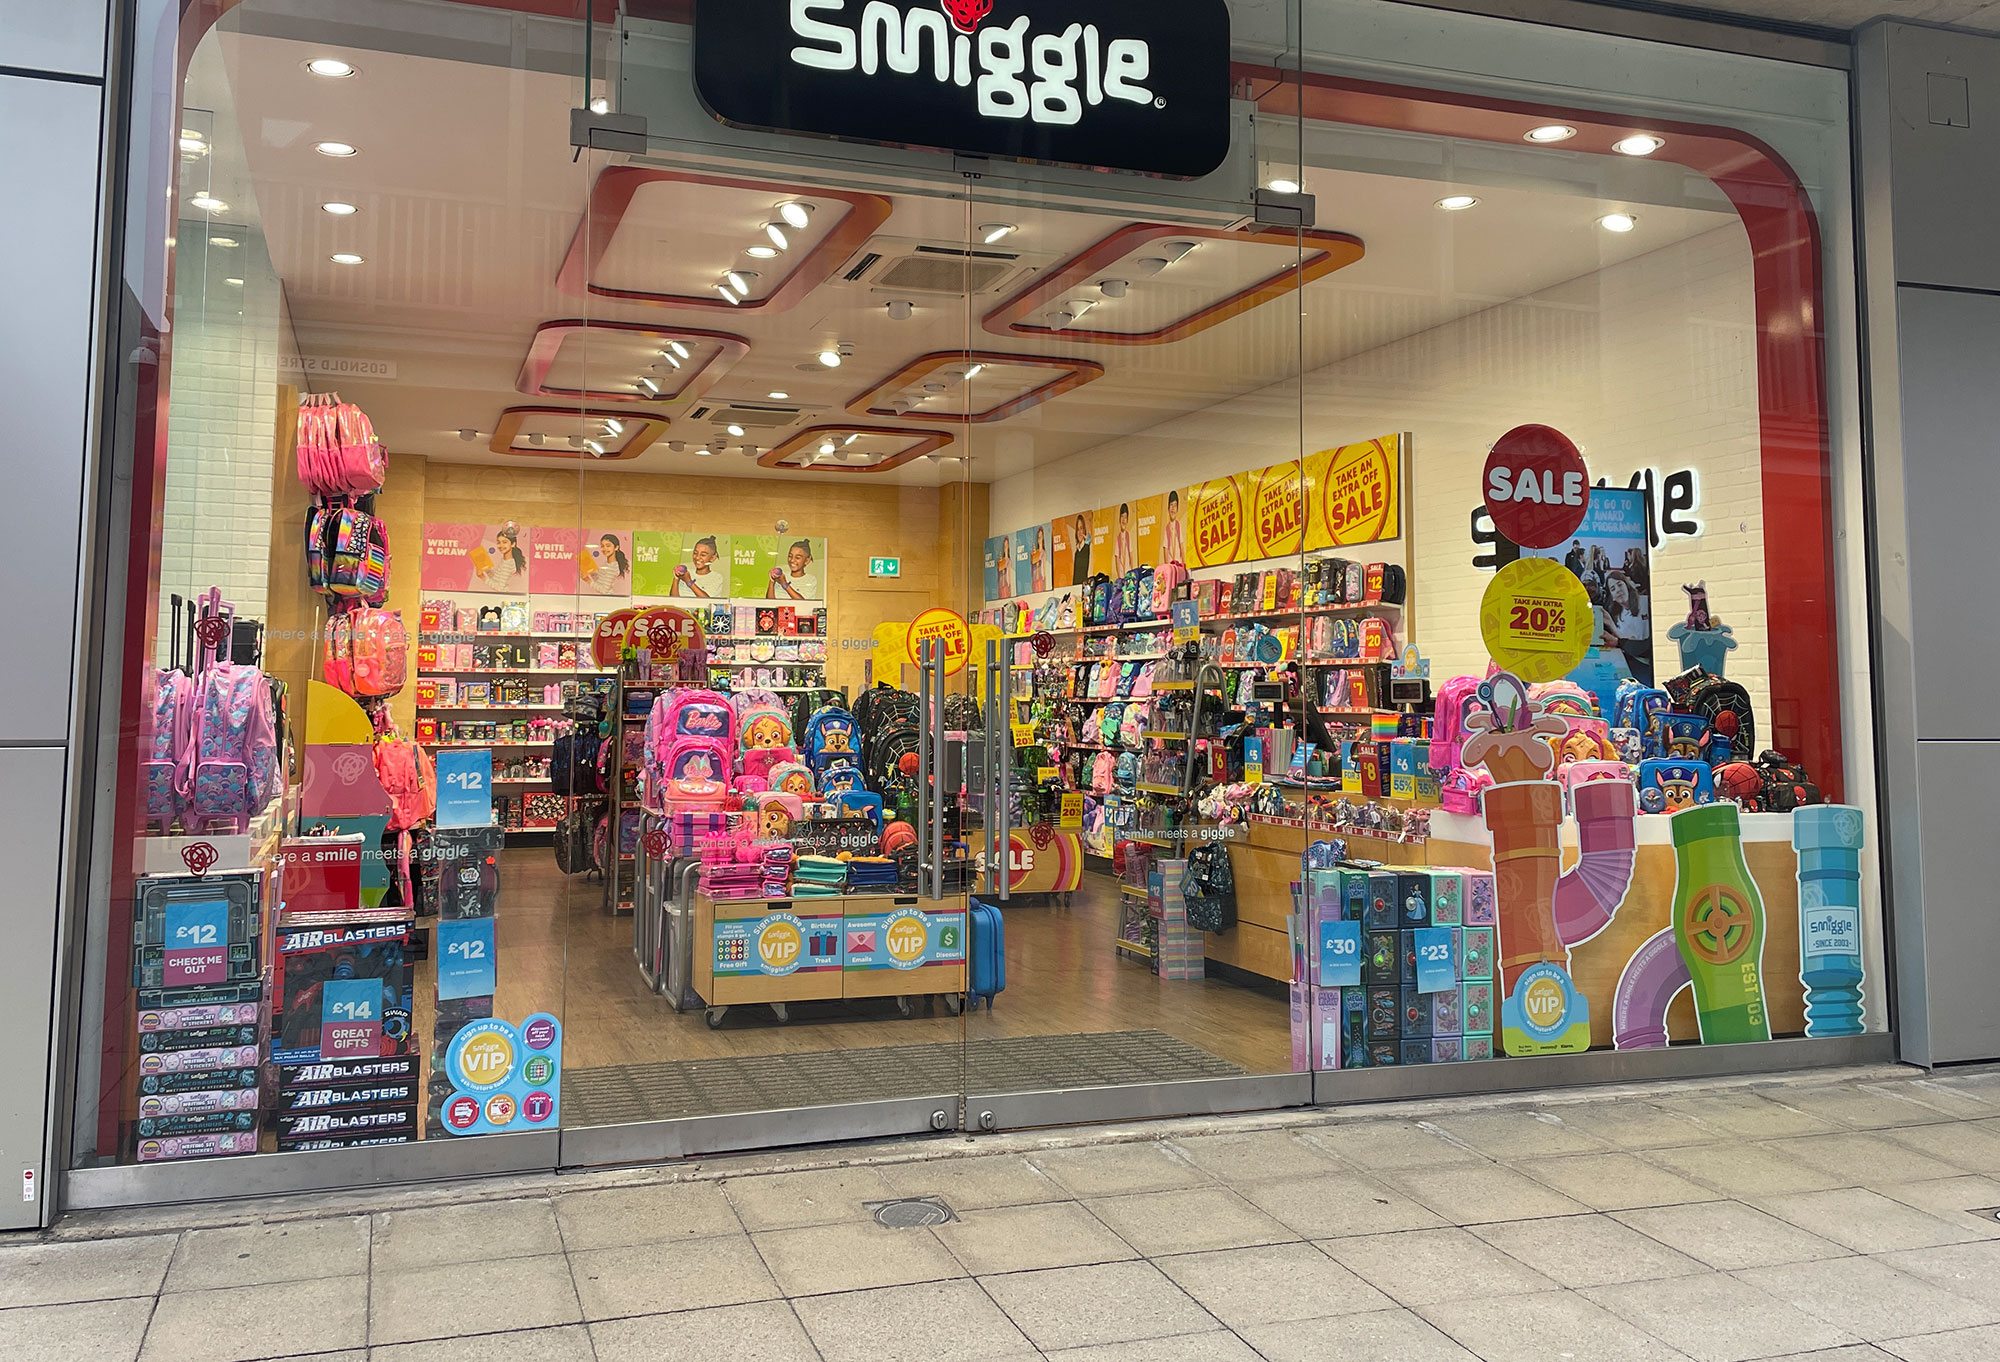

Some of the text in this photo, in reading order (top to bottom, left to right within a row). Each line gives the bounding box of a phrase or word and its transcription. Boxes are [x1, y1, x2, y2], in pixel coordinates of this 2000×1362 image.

[1336, 458, 1372, 486] TAKE AN
[1264, 477, 1295, 503] TAKE AN
[1333, 468, 1378, 502] EXTRA OFF
[1488, 466, 1583, 506] SALE
[1203, 492, 1229, 515] TAKE AN
[1262, 487, 1299, 518] EXTRA OFF
[1332, 482, 1383, 530] SALE
[1604, 500, 1616, 509] GO
[1622, 500, 1632, 510] TO
[1200, 501, 1233, 529] EXTRA OFF
[1262, 499, 1301, 543] SALE
[1594, 510, 1624, 521] AWARD
[1200, 512, 1237, 553] SALE
[428, 539, 458, 548] WRITE
[535, 543, 564, 552] WRITE
[637, 546, 660, 555] PLAY
[437, 548, 467, 556] DRAW
[543, 552, 572, 560] DRAW
[637, 554, 658, 562] TIME
[734, 550, 756, 558] PLAY
[734, 557, 755, 565] TIME
[1368, 577, 1382, 589] £12
[1181, 610, 1191, 624] £5
[1510, 606, 1565, 631] 20%
[634, 619, 695, 637] SALE
[919, 623, 955, 636] TAKE AN
[945, 630, 962, 638] OFF
[1549, 625, 1565, 633] OFF
[263, 628, 305, 640] where
[311, 632, 319, 640] a
[430, 630, 475, 644] giggle
[842, 636, 879, 650] giggle
[1366, 635, 1381, 647] £20
[685, 710, 722, 730] Barbie
[1249, 749, 1258, 760] £5
[1360, 746, 1375, 755] SALE
[1215, 753, 1224, 769] £6
[1397, 758, 1409, 771] £6
[1344, 770, 1355, 779] FOR
[1363, 762, 1377, 781] £8
[447, 772, 482, 789] £12
[1393, 779, 1412, 792] 55%
[700, 834, 879, 848] where a giggle
[1114, 830, 1121, 839] a
[1123, 829, 1155, 839] smile
[1157, 829, 1189, 839] meets
[1191, 830, 1198, 838] a
[1201, 827, 1235, 841] giggle
[302, 851, 310, 861] a
[315, 848, 358, 861] smile
[362, 849, 404, 860] meets
[410, 850, 418, 859] a
[422, 845, 469, 861] giggle
[753, 918, 770, 935] Sign
[792, 916, 803, 926] be
[881, 914, 897, 930] Sign
[909, 908, 917, 916] to
[918, 912, 928, 922] be
[1811, 916, 1852, 935] smiggle
[176, 925, 217, 944] £12
[323, 924, 406, 944] BLASTERS
[448, 940, 485, 959] £12
[762, 942, 798, 959] VIP
[890, 936, 923, 953] VIP
[1326, 939, 1356, 955] £30
[1815, 939, 1850, 948] SINCE 2003
[1421, 944, 1449, 961] £23
[169, 956, 222, 967] CHECK ME
[760, 960, 799, 974] smiggle.com
[184, 965, 206, 974] OUT
[1524, 973, 1536, 986] sign
[1553, 971, 1560, 980] be
[1741, 962, 1758, 993] EST
[1625, 980, 1635, 1000] SMILE
[332, 1001, 372, 1020] £14
[1529, 996, 1560, 1014] VIP
[384, 1008, 409, 1019] SWAP
[332, 1028, 373, 1039] GREAT
[460, 1027, 477, 1041] sign
[499, 1025, 509, 1034] be
[334, 1038, 369, 1049] GIFTS
[333, 1062, 410, 1077] BLASTERS
[465, 1052, 506, 1072] VIP
[332, 1087, 409, 1102] BLASTERS
[330, 1112, 407, 1127] BLASTERS
